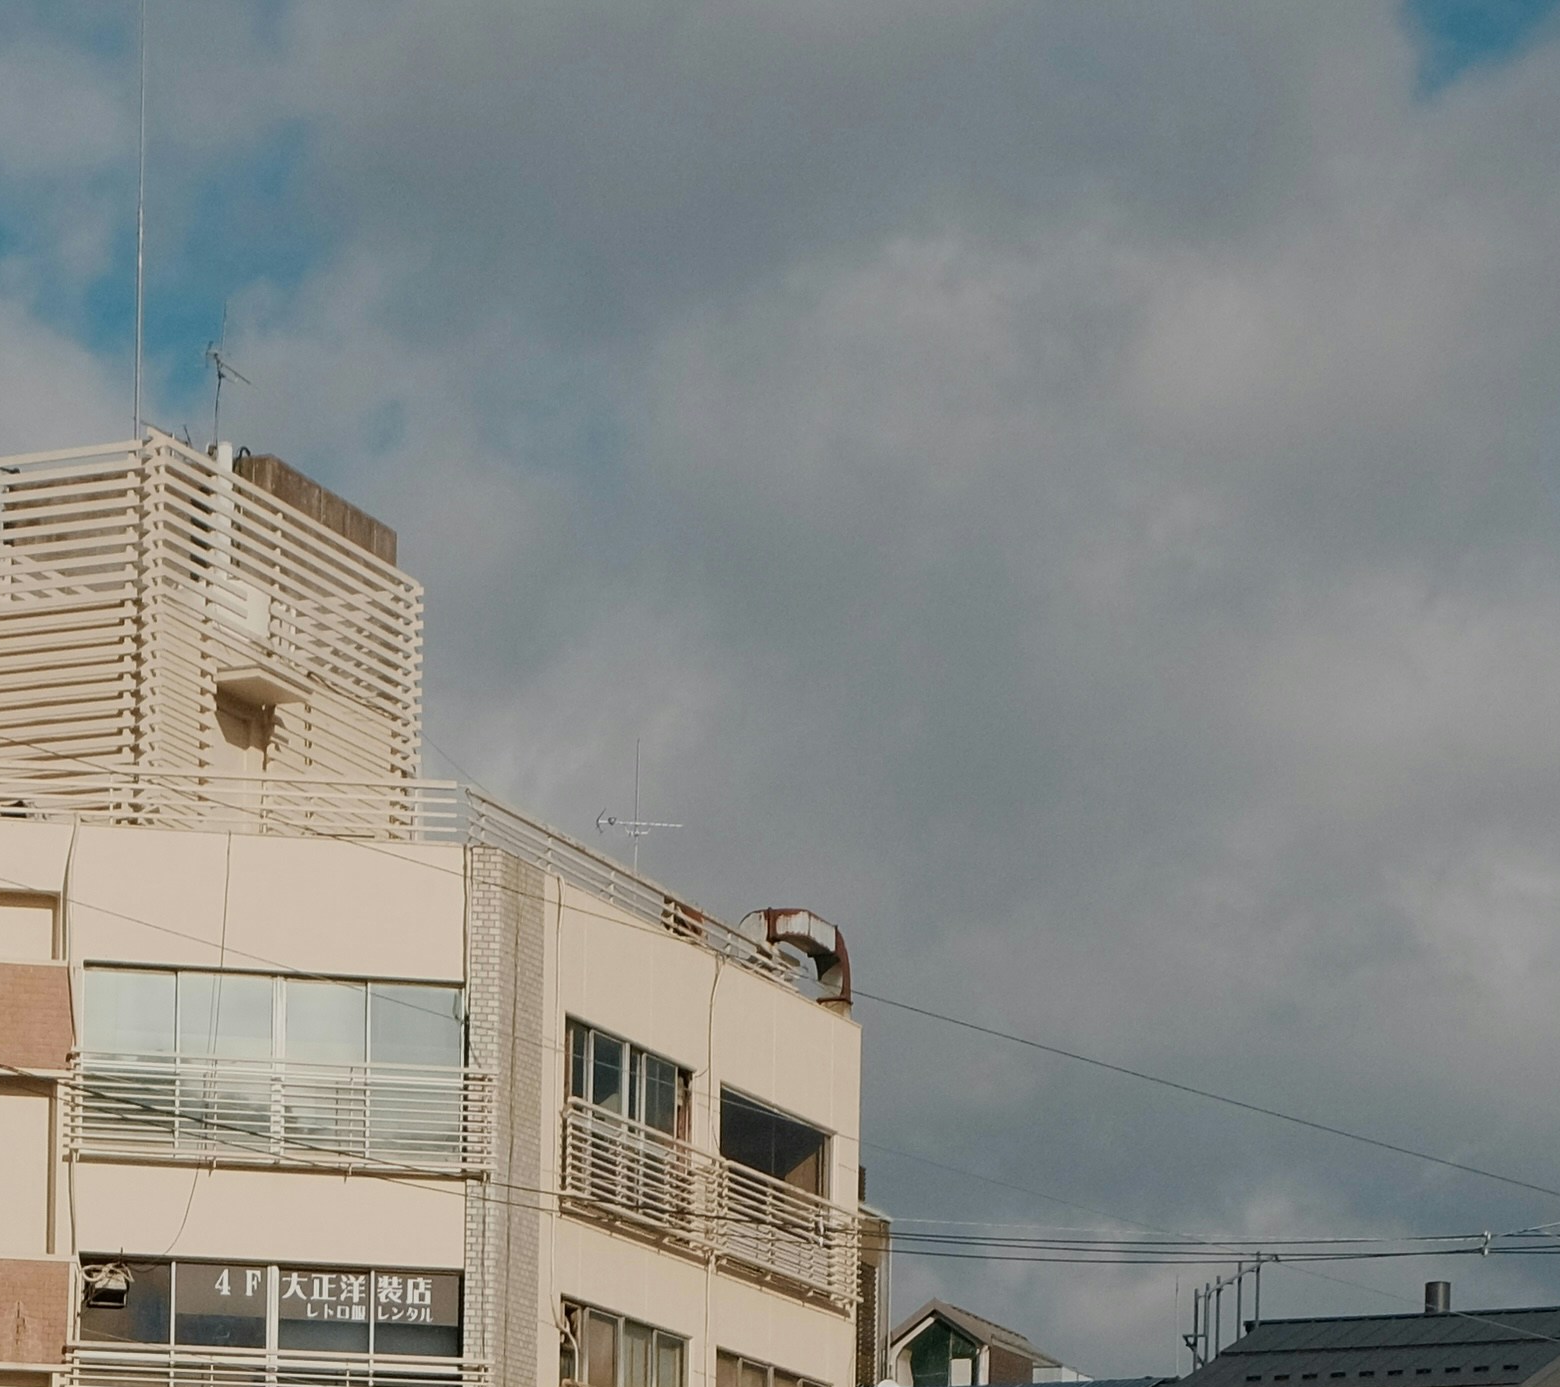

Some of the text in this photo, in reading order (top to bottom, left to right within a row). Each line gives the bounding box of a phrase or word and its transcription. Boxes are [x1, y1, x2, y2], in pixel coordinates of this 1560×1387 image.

[282, 1272, 432, 1304] 大正洋装店
